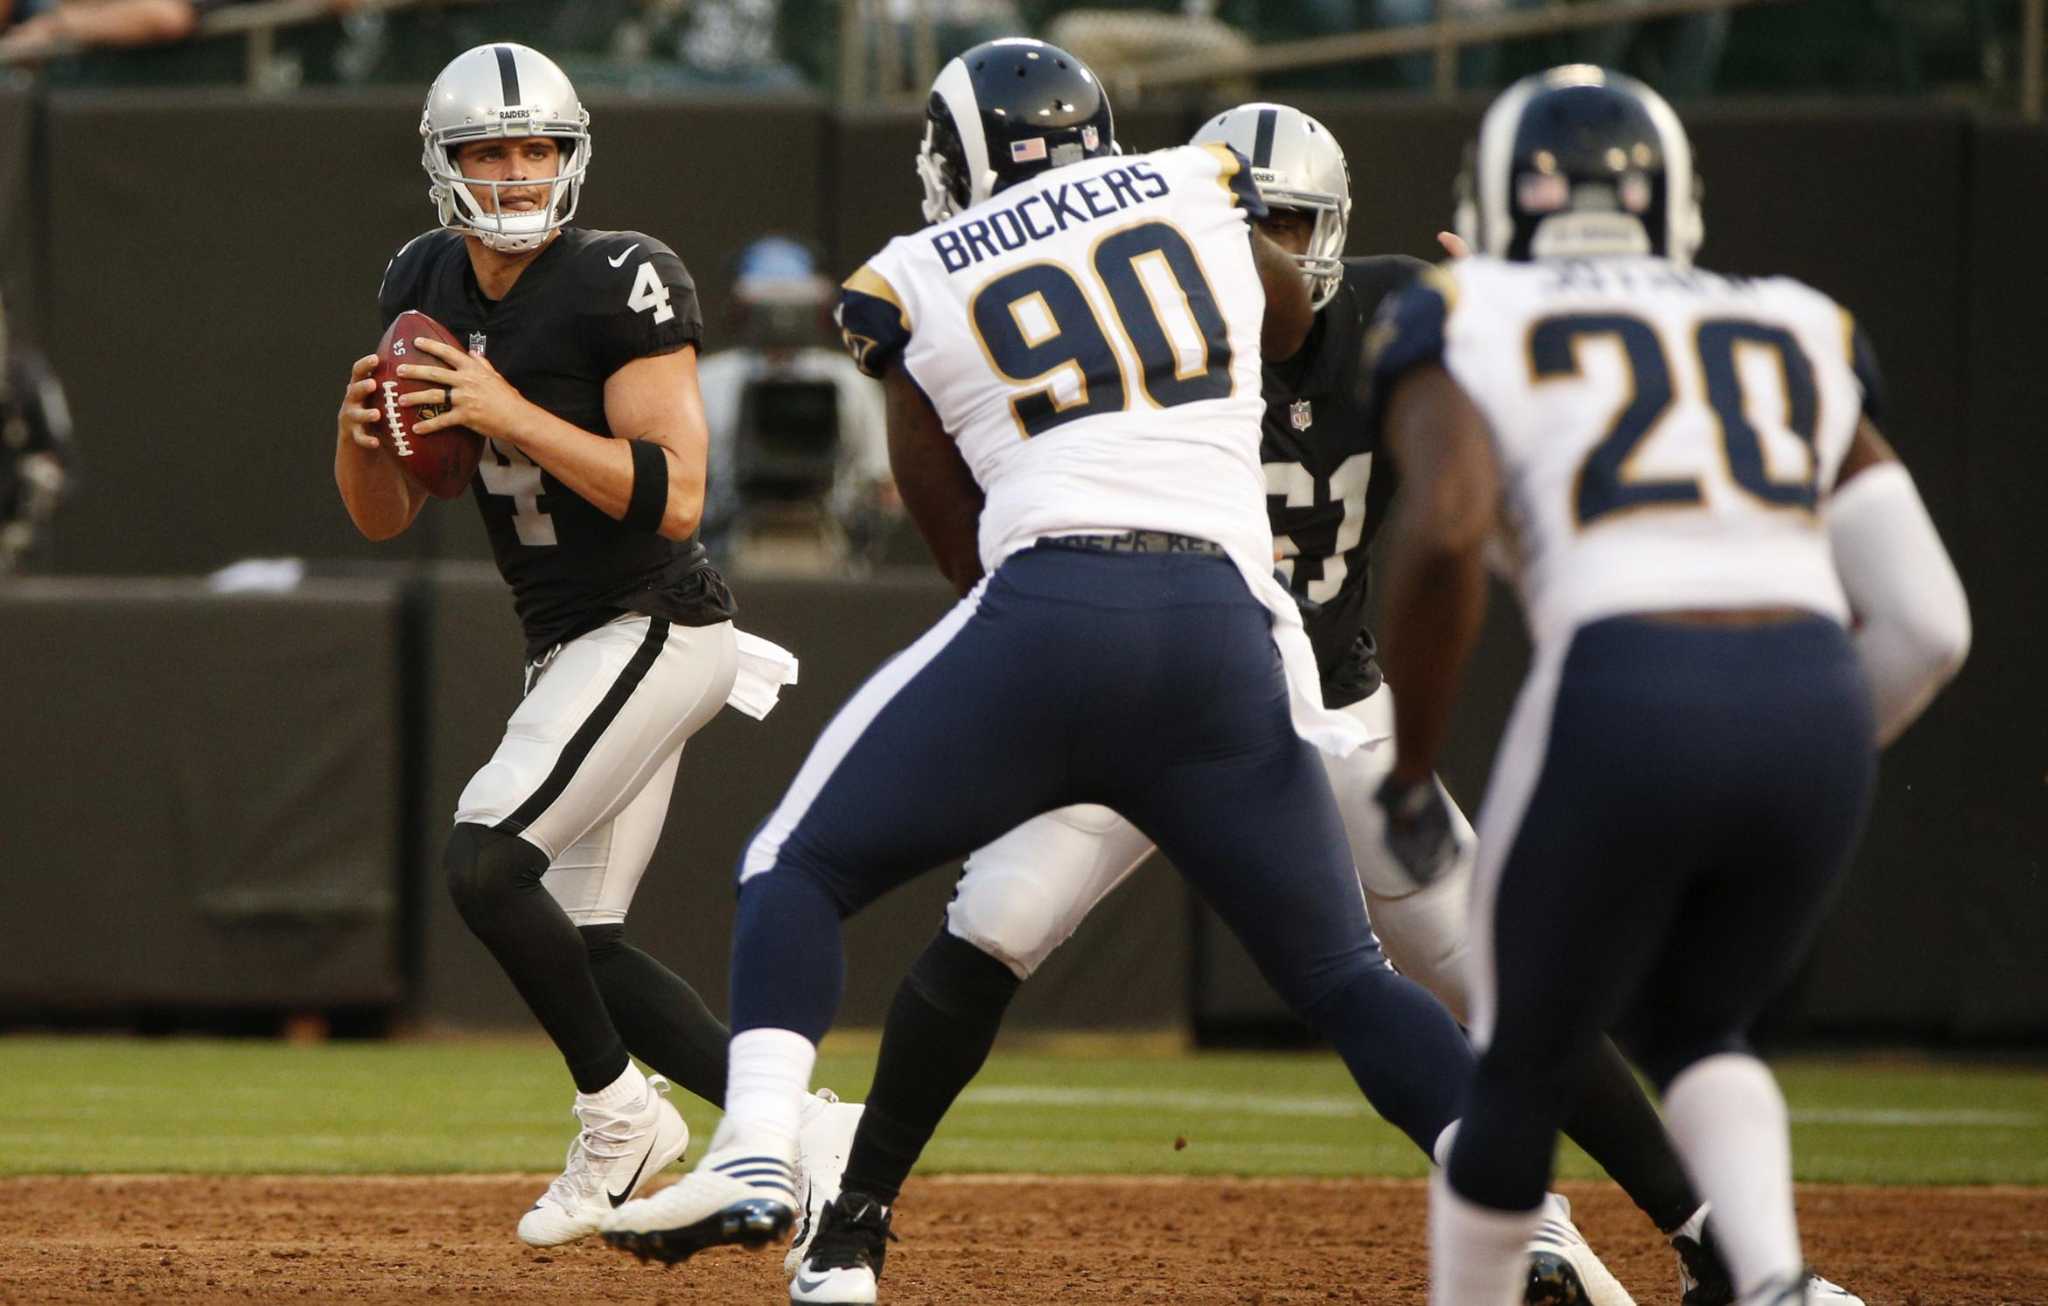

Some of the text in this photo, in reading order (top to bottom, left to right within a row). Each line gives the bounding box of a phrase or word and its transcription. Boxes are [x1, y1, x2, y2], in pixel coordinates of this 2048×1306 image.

[499, 110, 530, 119] RAIDERS
[930, 161, 1170, 274] BROCKERS
[627, 261, 675, 325] 4
[966, 216, 1237, 441] 90
[1527, 313, 1822, 530] 20
[478, 436, 558, 546] 4
